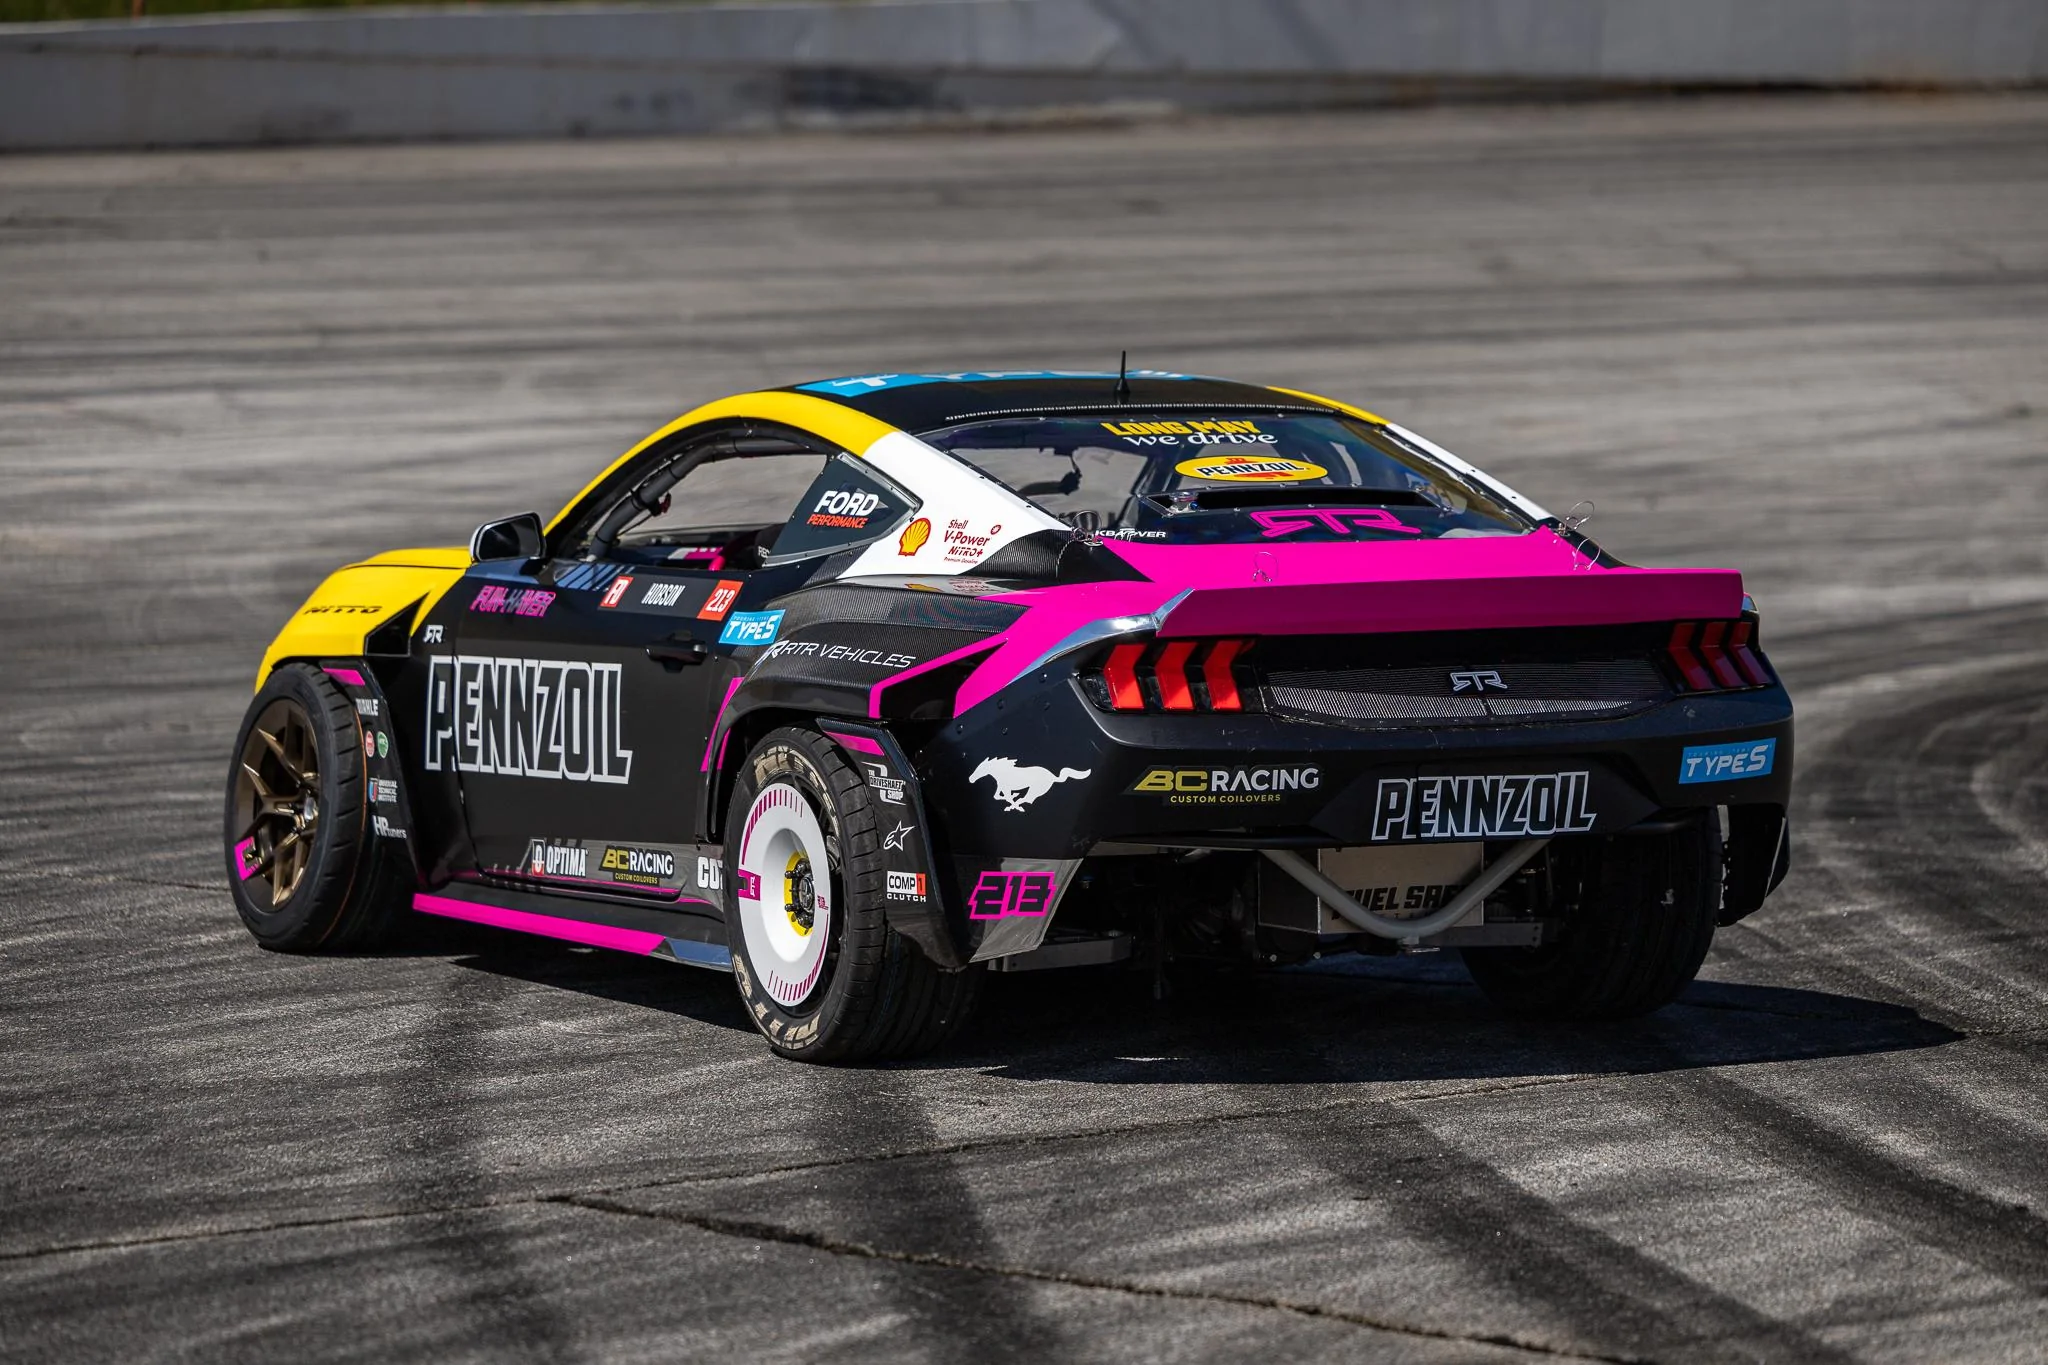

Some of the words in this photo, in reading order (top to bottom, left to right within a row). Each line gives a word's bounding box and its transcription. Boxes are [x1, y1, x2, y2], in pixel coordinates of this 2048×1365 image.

[1101, 421, 1192, 436] LONG
[1186, 421, 1261, 434] MAY
[1123, 435, 1179, 446] we
[1187, 432, 1278, 445] drive
[1196, 462, 1305, 477] PENNZOIL
[813, 490, 879, 516] FORD
[806, 513, 869, 529] PERFORMANCE
[948, 519, 969, 530] Shell
[943, 530, 990, 546] V-Power
[705, 588, 736, 613] 213
[780, 641, 819, 656] RTR
[819, 643, 917, 668] VEHICLES
[424, 655, 633, 785] PENNZOIL
[1170, 795, 1216, 803] CUSTOM
[1219, 794, 1281, 803] COILOVERS
[1371, 770, 1597, 841] PENNZOIL
[546, 846, 586, 877] OPTIMA
[615, 872, 633, 882] CUSTOM
[633, 874, 658, 885] COILOVERS
[886, 892, 927, 903] CLUTCH
[968, 871, 1057, 919] 213
[1346, 886, 1399, 912] UEL
